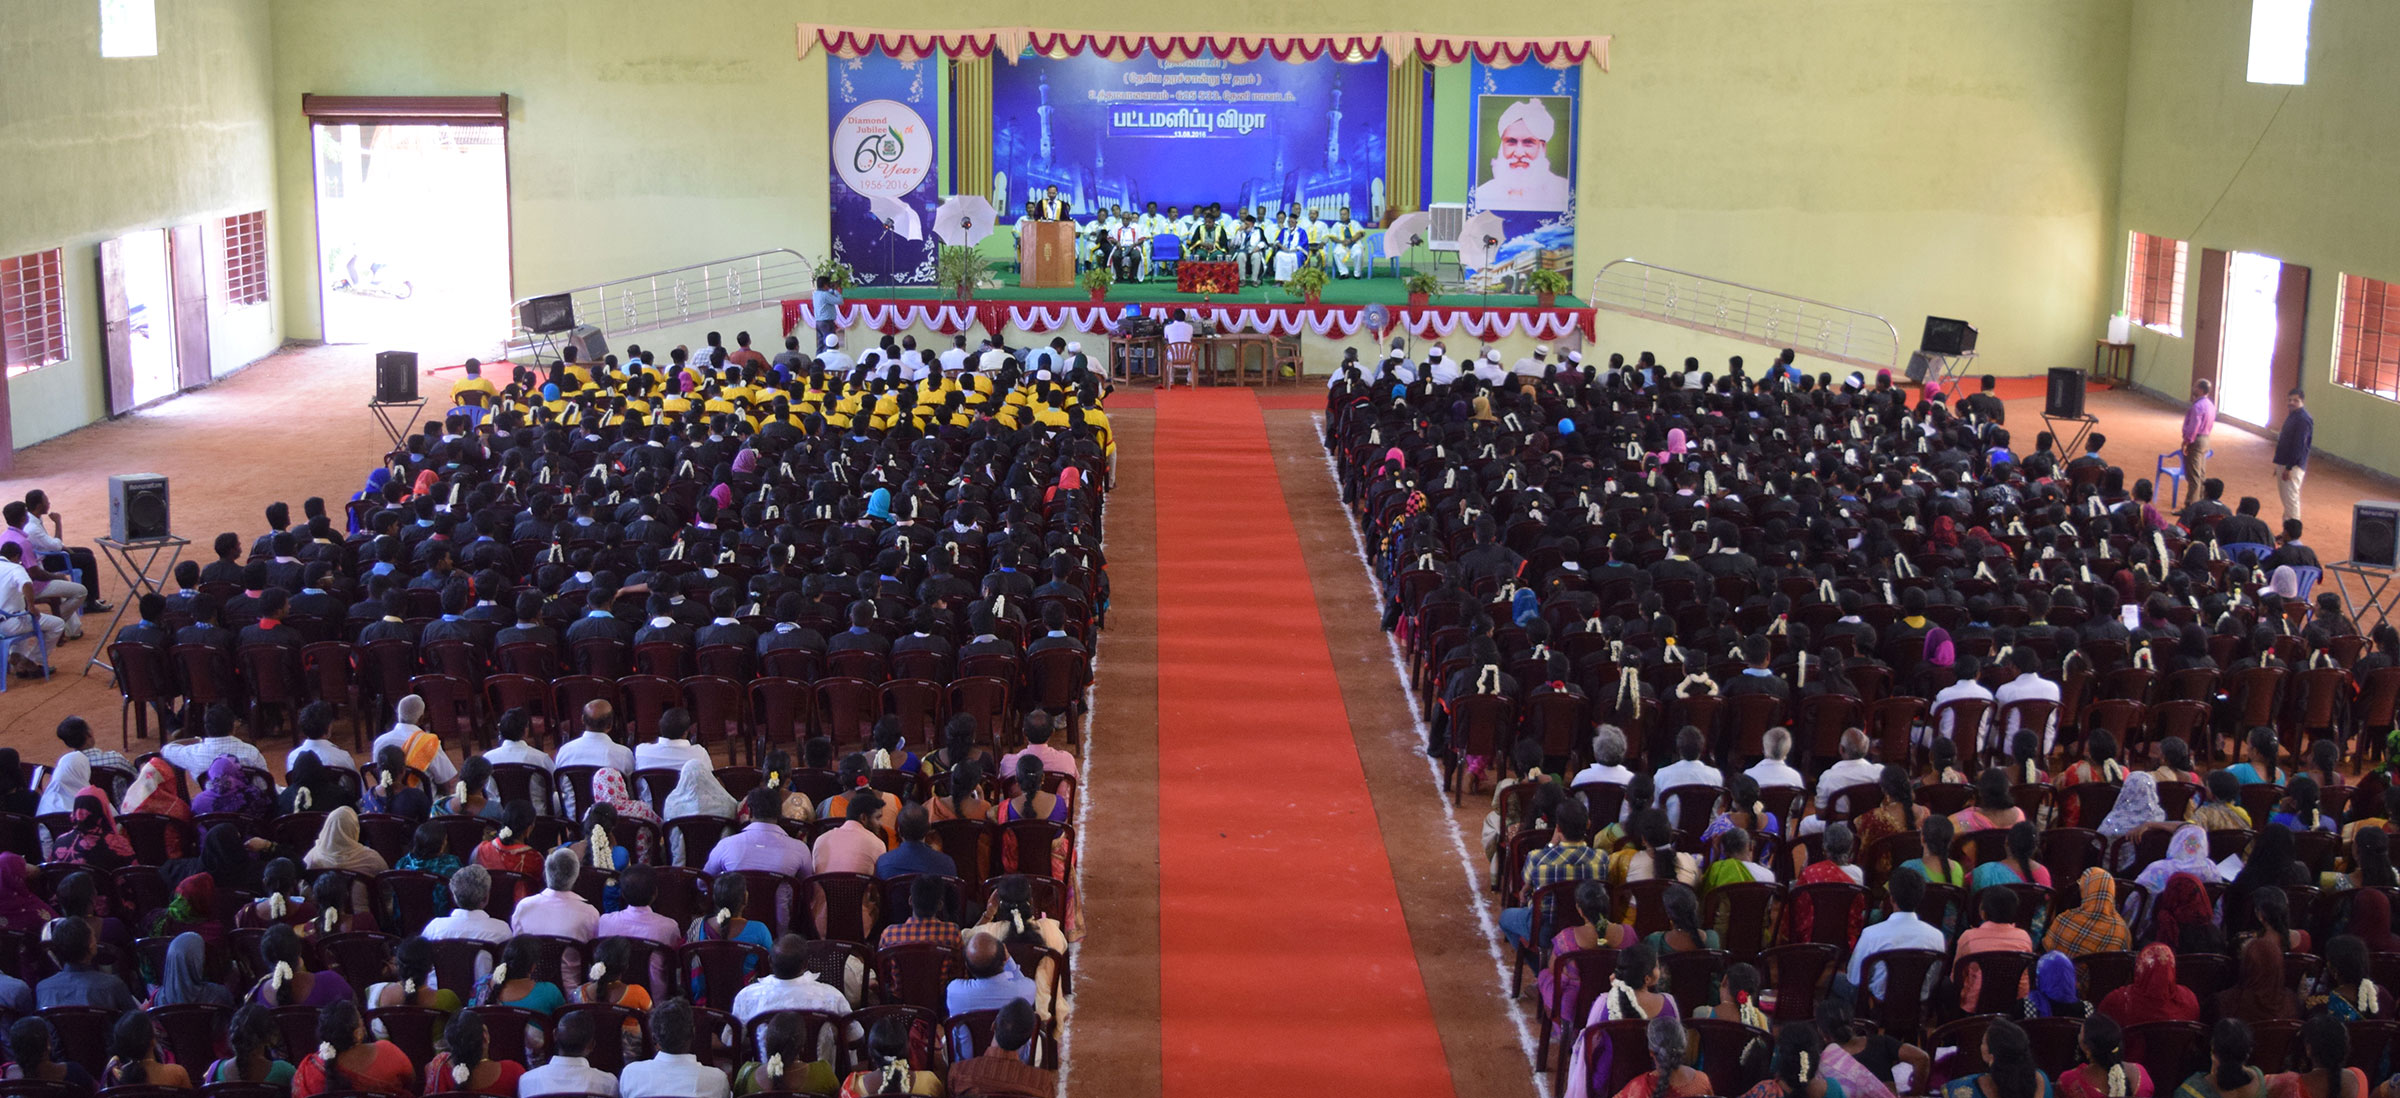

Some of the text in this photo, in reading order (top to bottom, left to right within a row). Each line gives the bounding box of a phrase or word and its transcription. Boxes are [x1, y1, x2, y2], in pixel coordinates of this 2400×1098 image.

[848, 116, 887, 124] Diamond
[1113, 108, 1267, 135] பட்டமளிப்பு விழா
[877, 163, 920, 178] Year
[860, 180, 909, 190] 1956-2016
